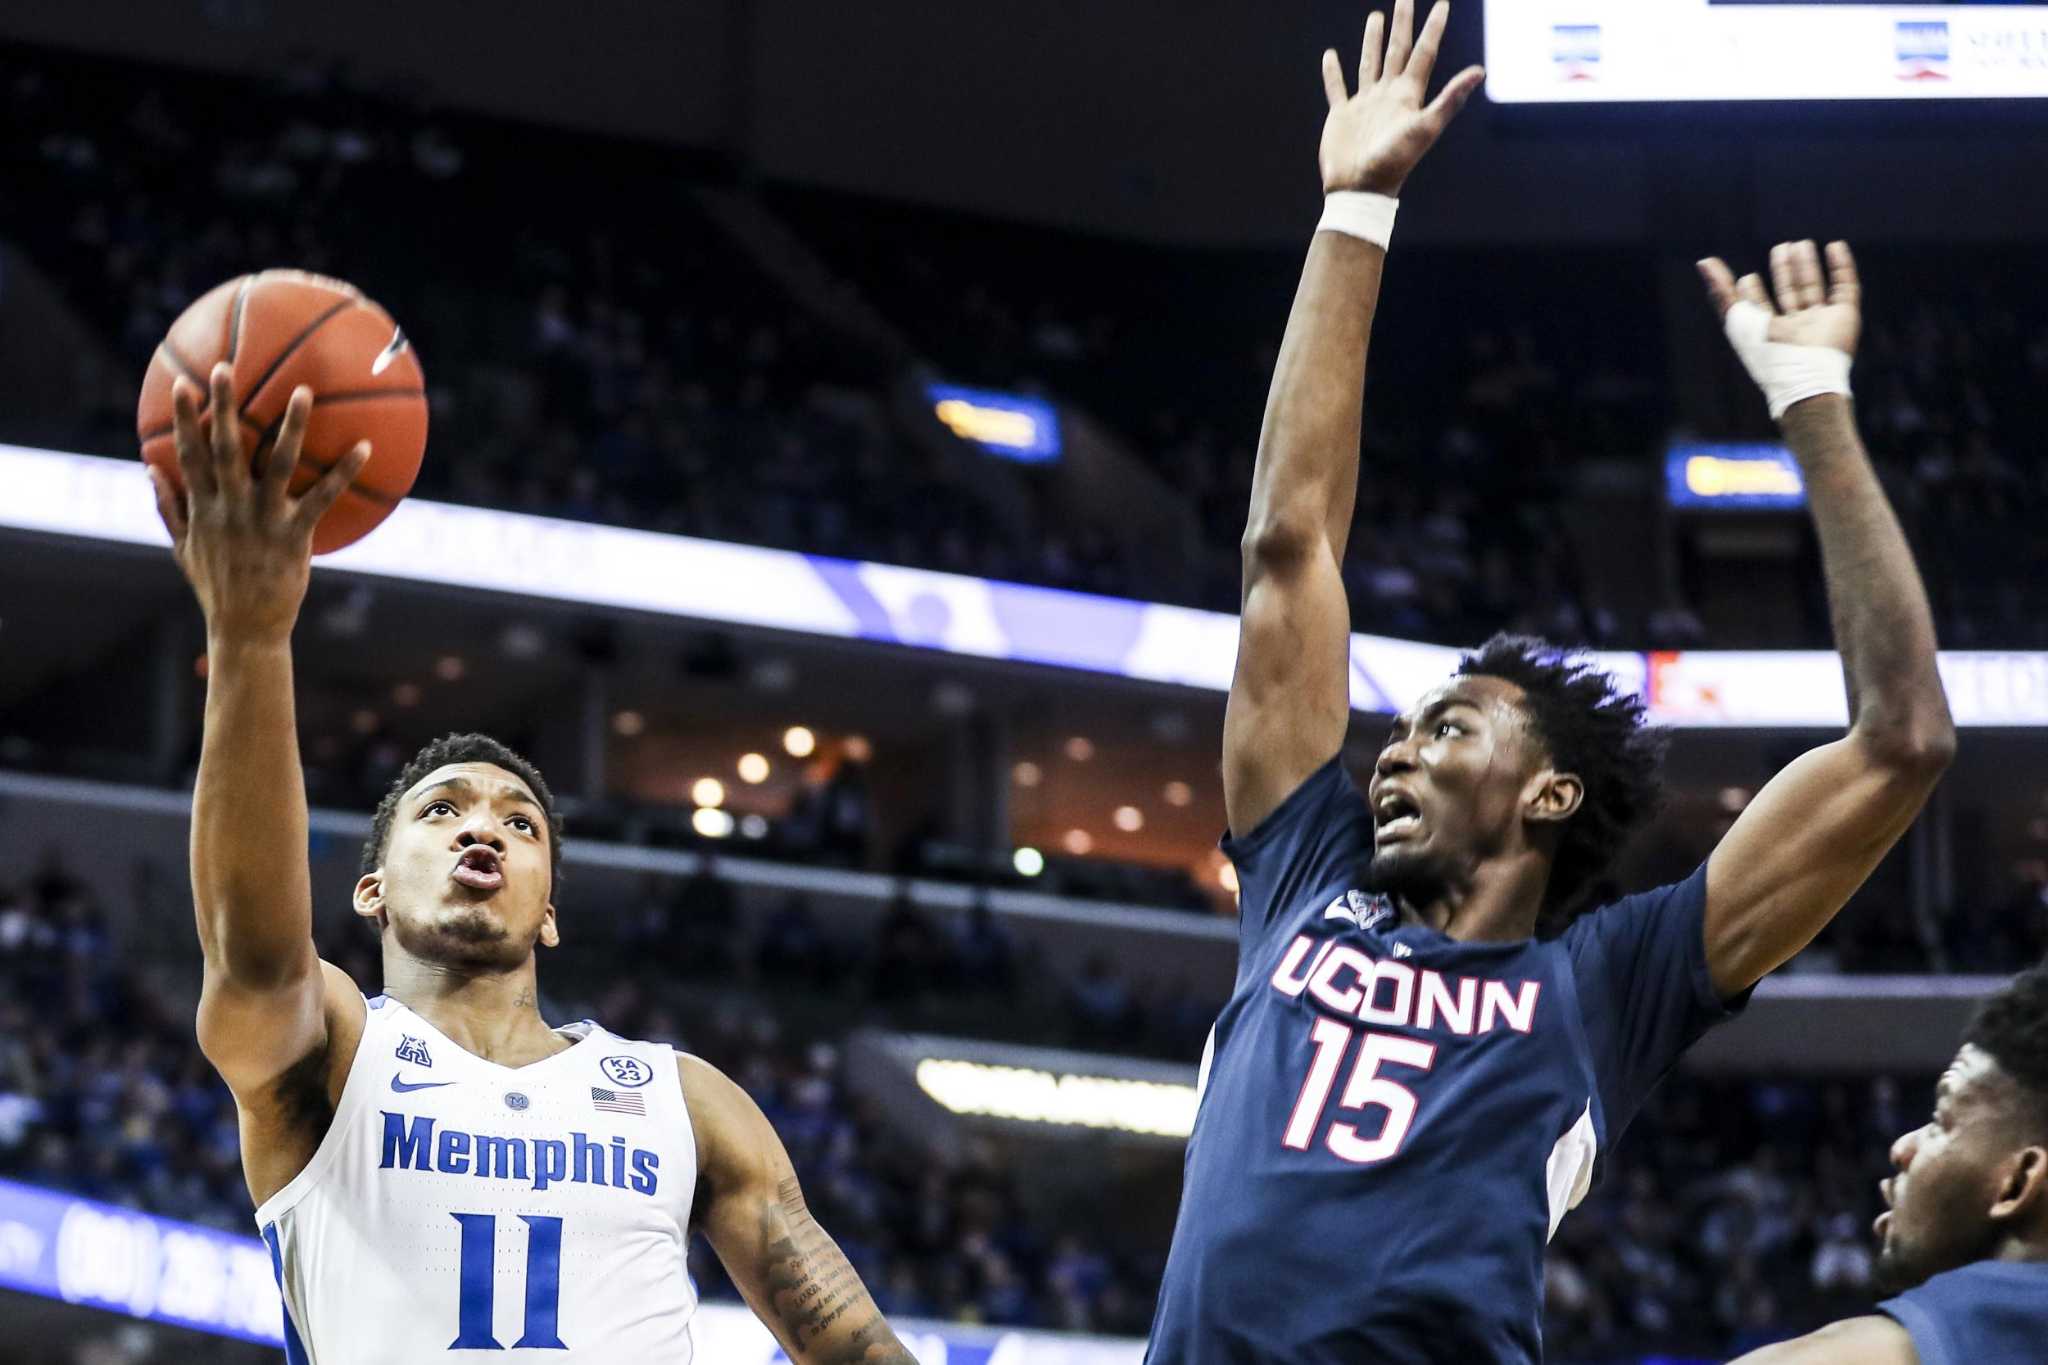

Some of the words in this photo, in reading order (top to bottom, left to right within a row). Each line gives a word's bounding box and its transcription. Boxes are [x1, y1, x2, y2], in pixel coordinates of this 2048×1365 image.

[1270, 934, 1541, 1036] UCONN
[610, 1059, 639, 1070] KA
[615, 1068, 641, 1081] 23
[1281, 1016, 1438, 1164] 15
[379, 1110, 660, 1197] Memphis
[448, 1212, 569, 1350] 11
